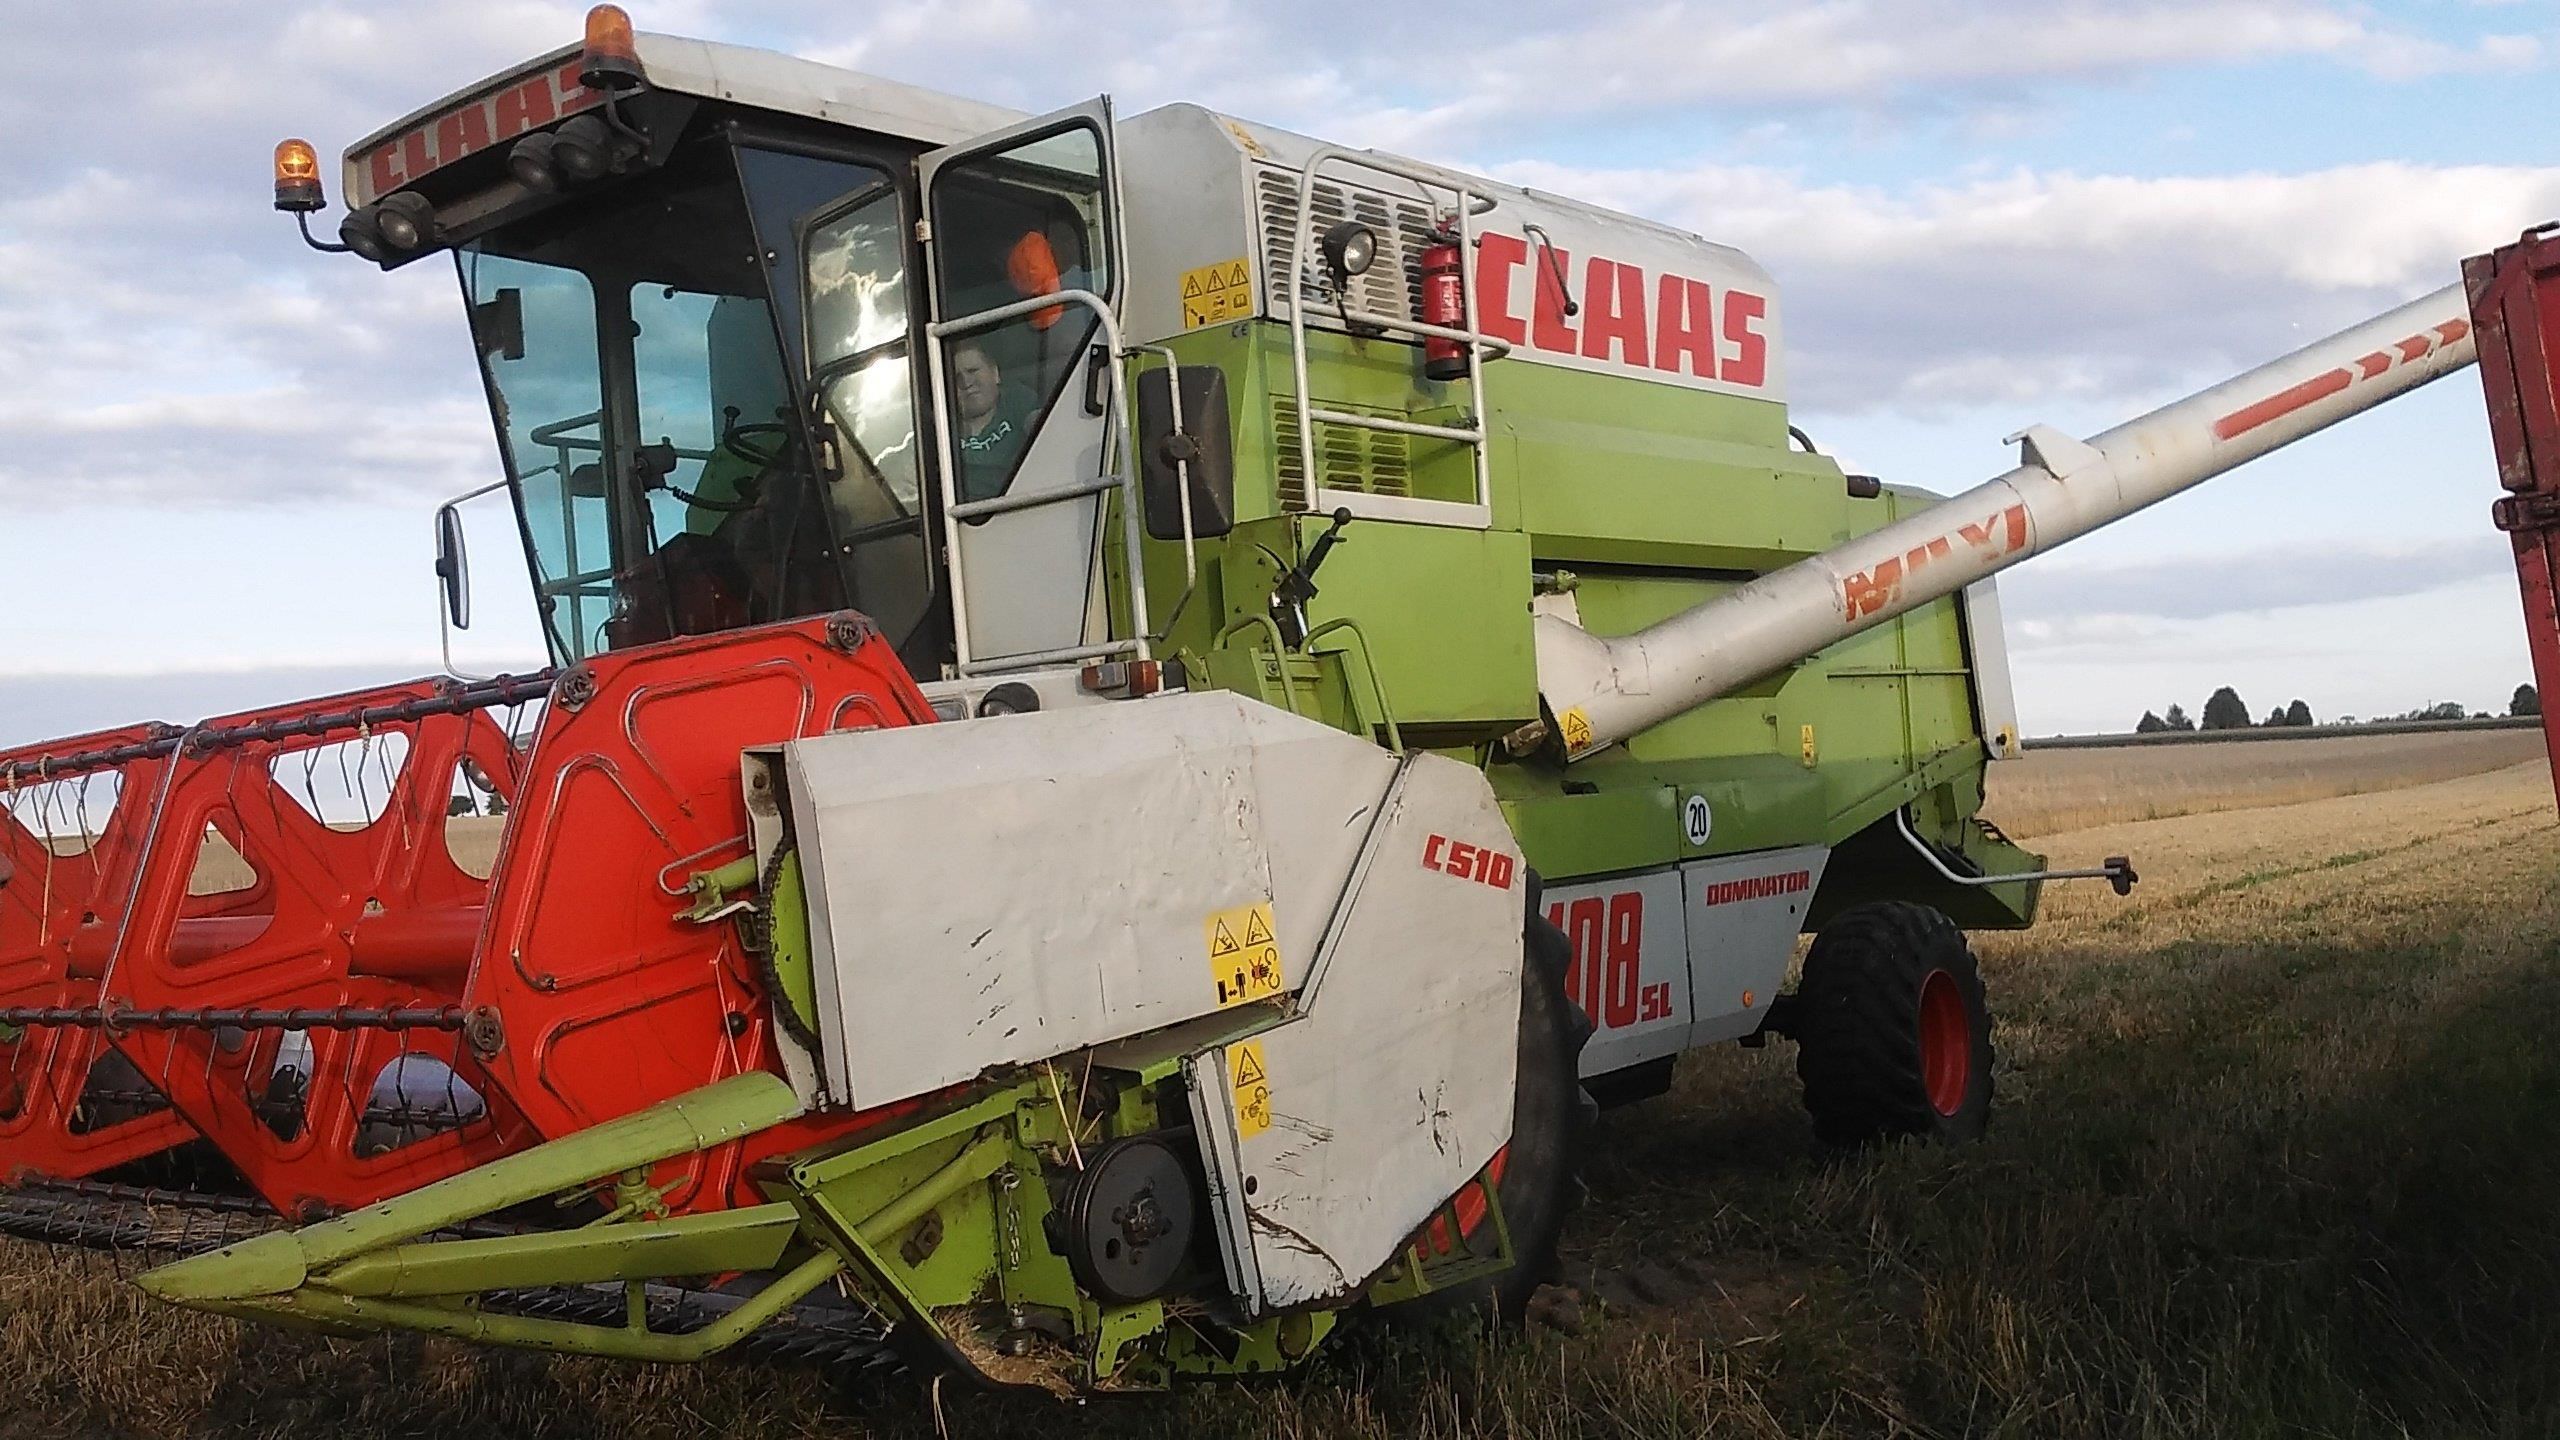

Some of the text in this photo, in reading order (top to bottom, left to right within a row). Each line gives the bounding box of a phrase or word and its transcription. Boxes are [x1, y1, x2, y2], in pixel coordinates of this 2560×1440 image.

[1475, 230, 1766, 388] CLAAS
[1689, 803, 1707, 838] 20
[1706, 870, 1810, 907] DOMINATOR
[1544, 891, 1673, 1030] 08 SL
